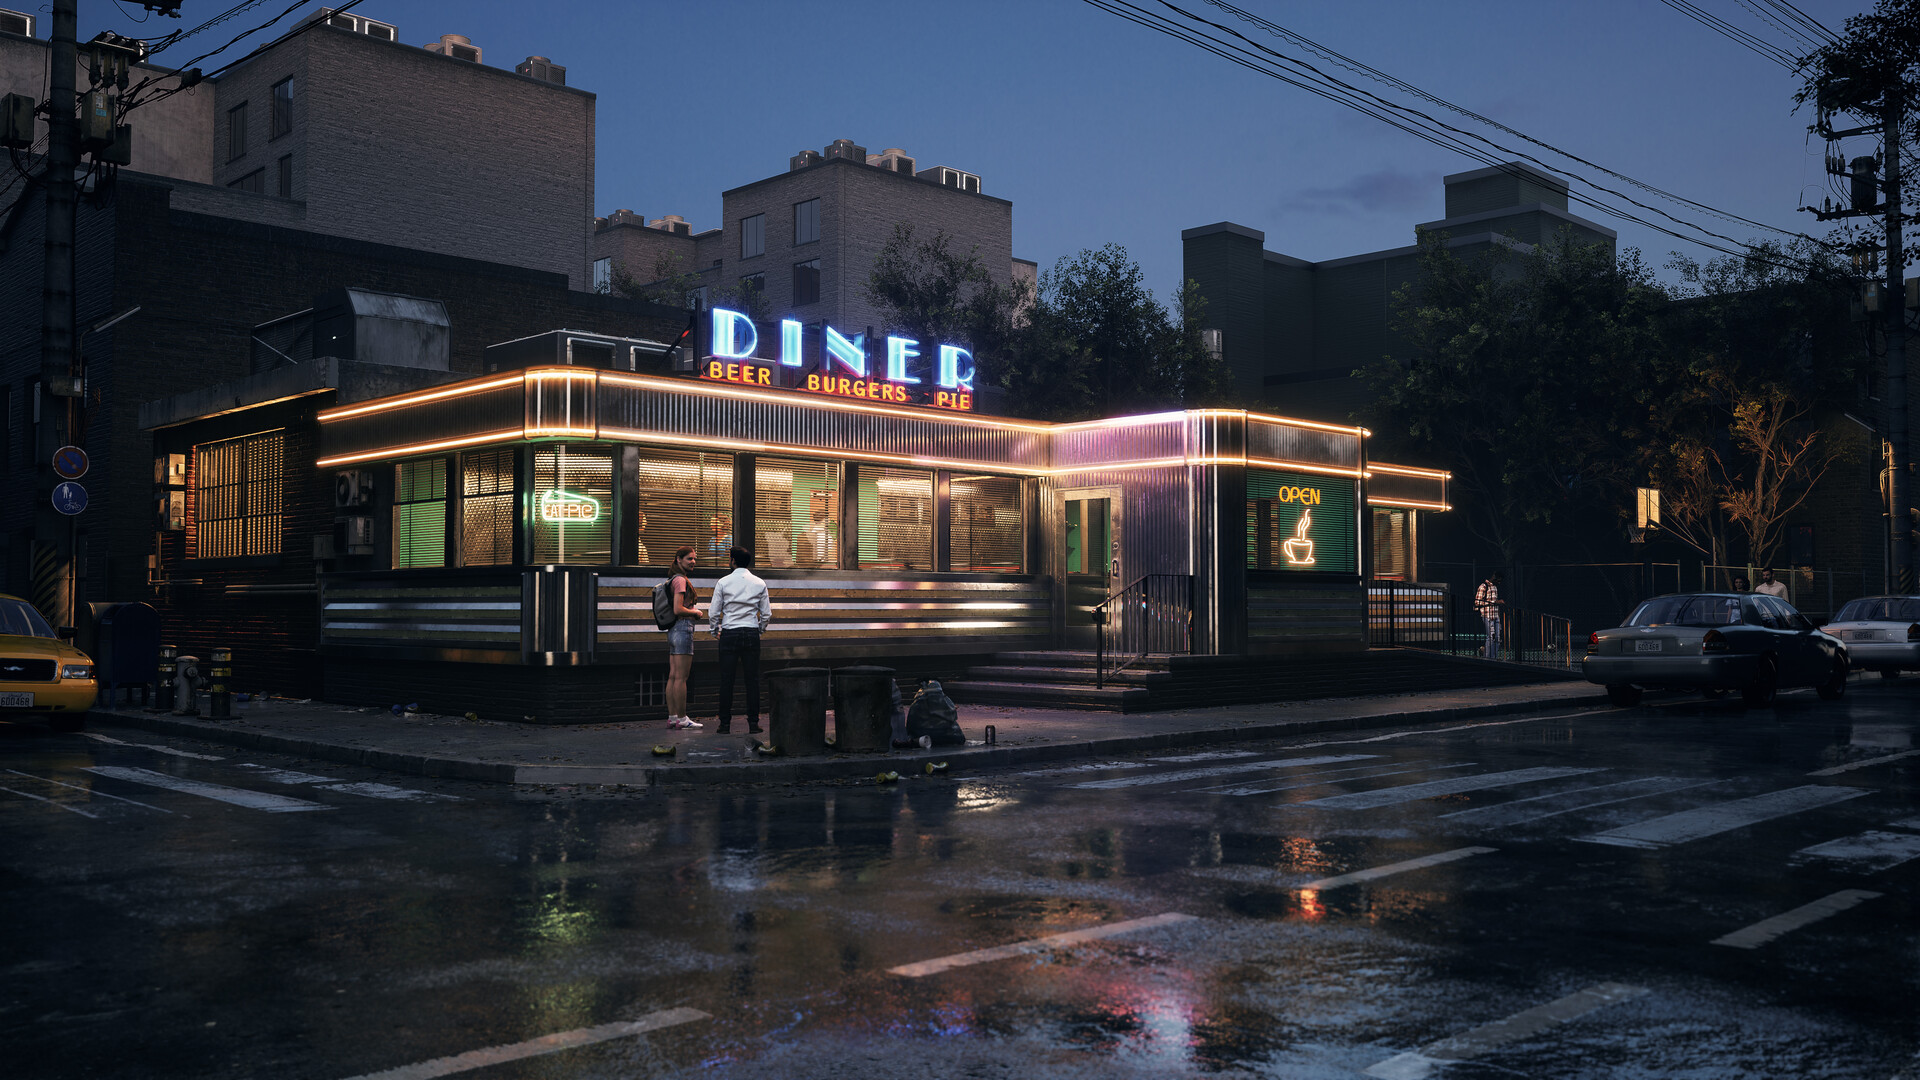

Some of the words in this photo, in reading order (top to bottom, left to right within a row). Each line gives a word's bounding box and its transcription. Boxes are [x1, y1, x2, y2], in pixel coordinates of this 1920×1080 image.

[712, 307, 976, 390] DINER
[709, 361, 771, 385] BEER
[807, 374, 907, 402] BURGERS
[938, 391, 970, 410] PIE
[1279, 486, 1320, 505] OPEN
